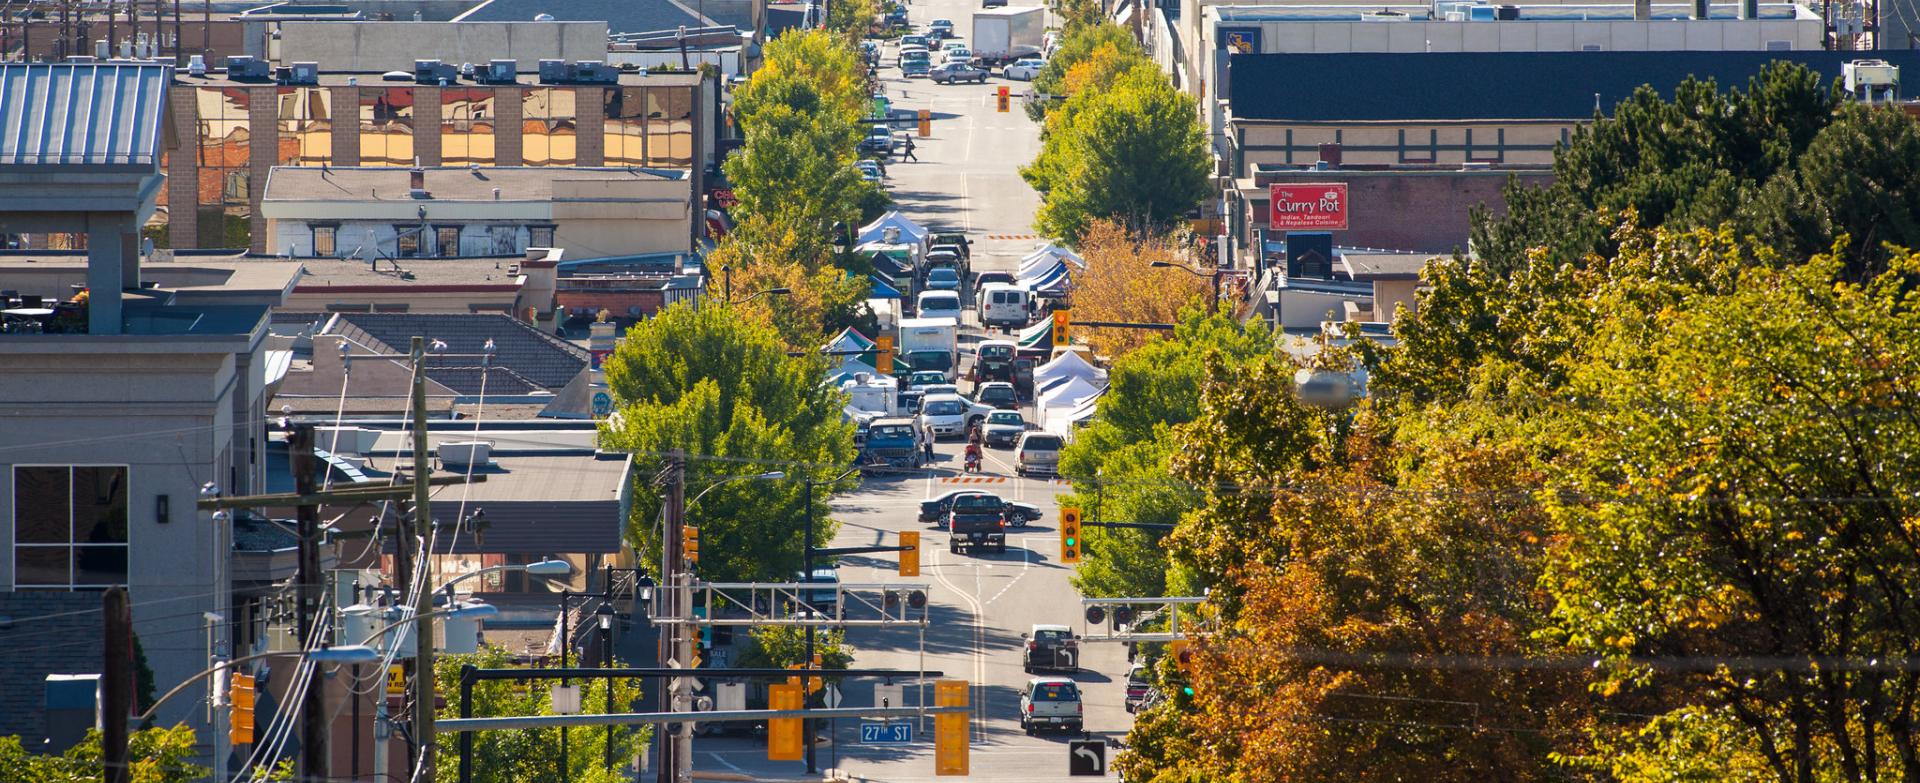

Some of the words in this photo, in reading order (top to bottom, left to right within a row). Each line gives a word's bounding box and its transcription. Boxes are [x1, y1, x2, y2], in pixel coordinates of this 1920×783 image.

[1277, 199, 1316, 214] Curry
[1319, 198, 1340, 212] Pot
[894, 726, 909, 741] ST
